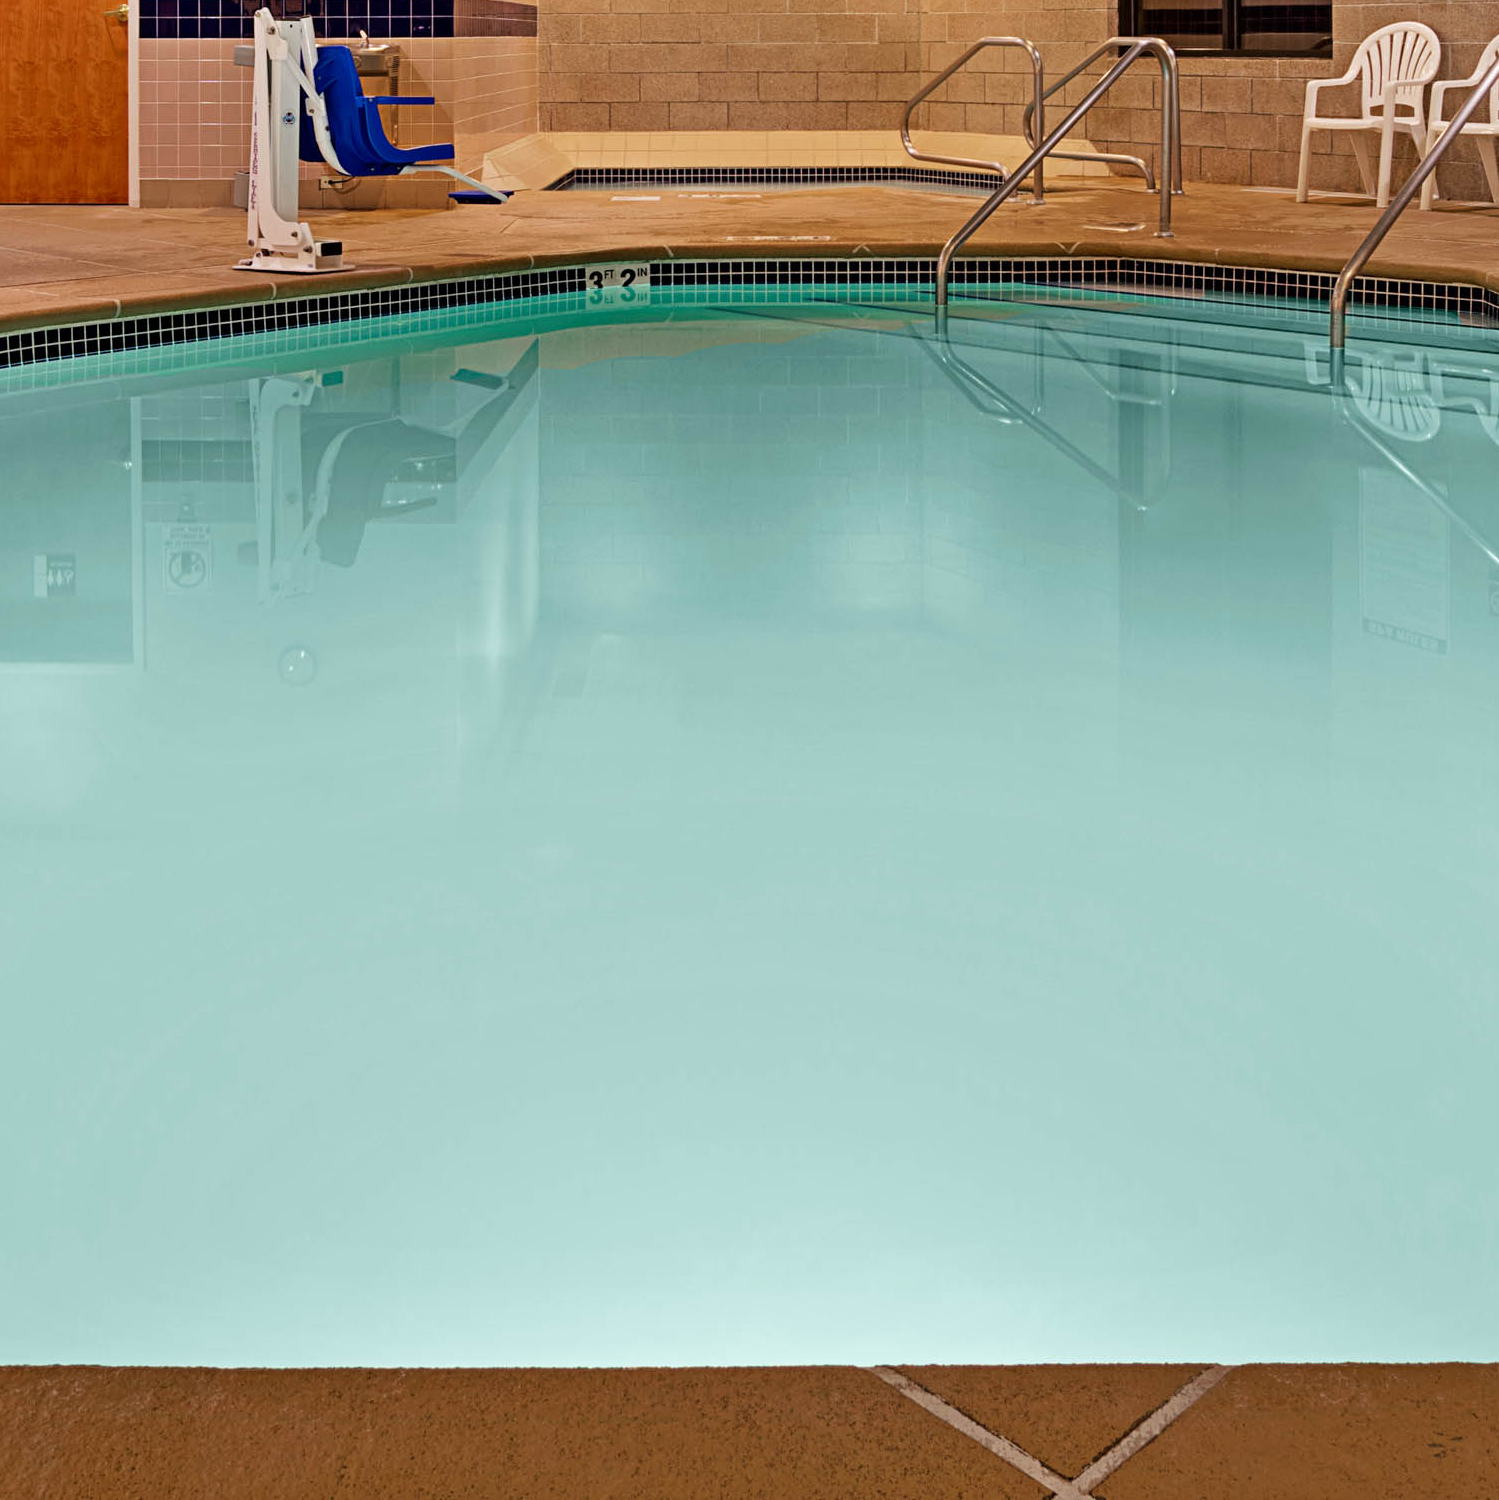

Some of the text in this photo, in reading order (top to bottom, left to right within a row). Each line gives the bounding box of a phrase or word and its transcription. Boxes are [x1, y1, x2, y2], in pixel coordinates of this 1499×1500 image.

[589, 267, 647, 289] 3 FT 2 IN
